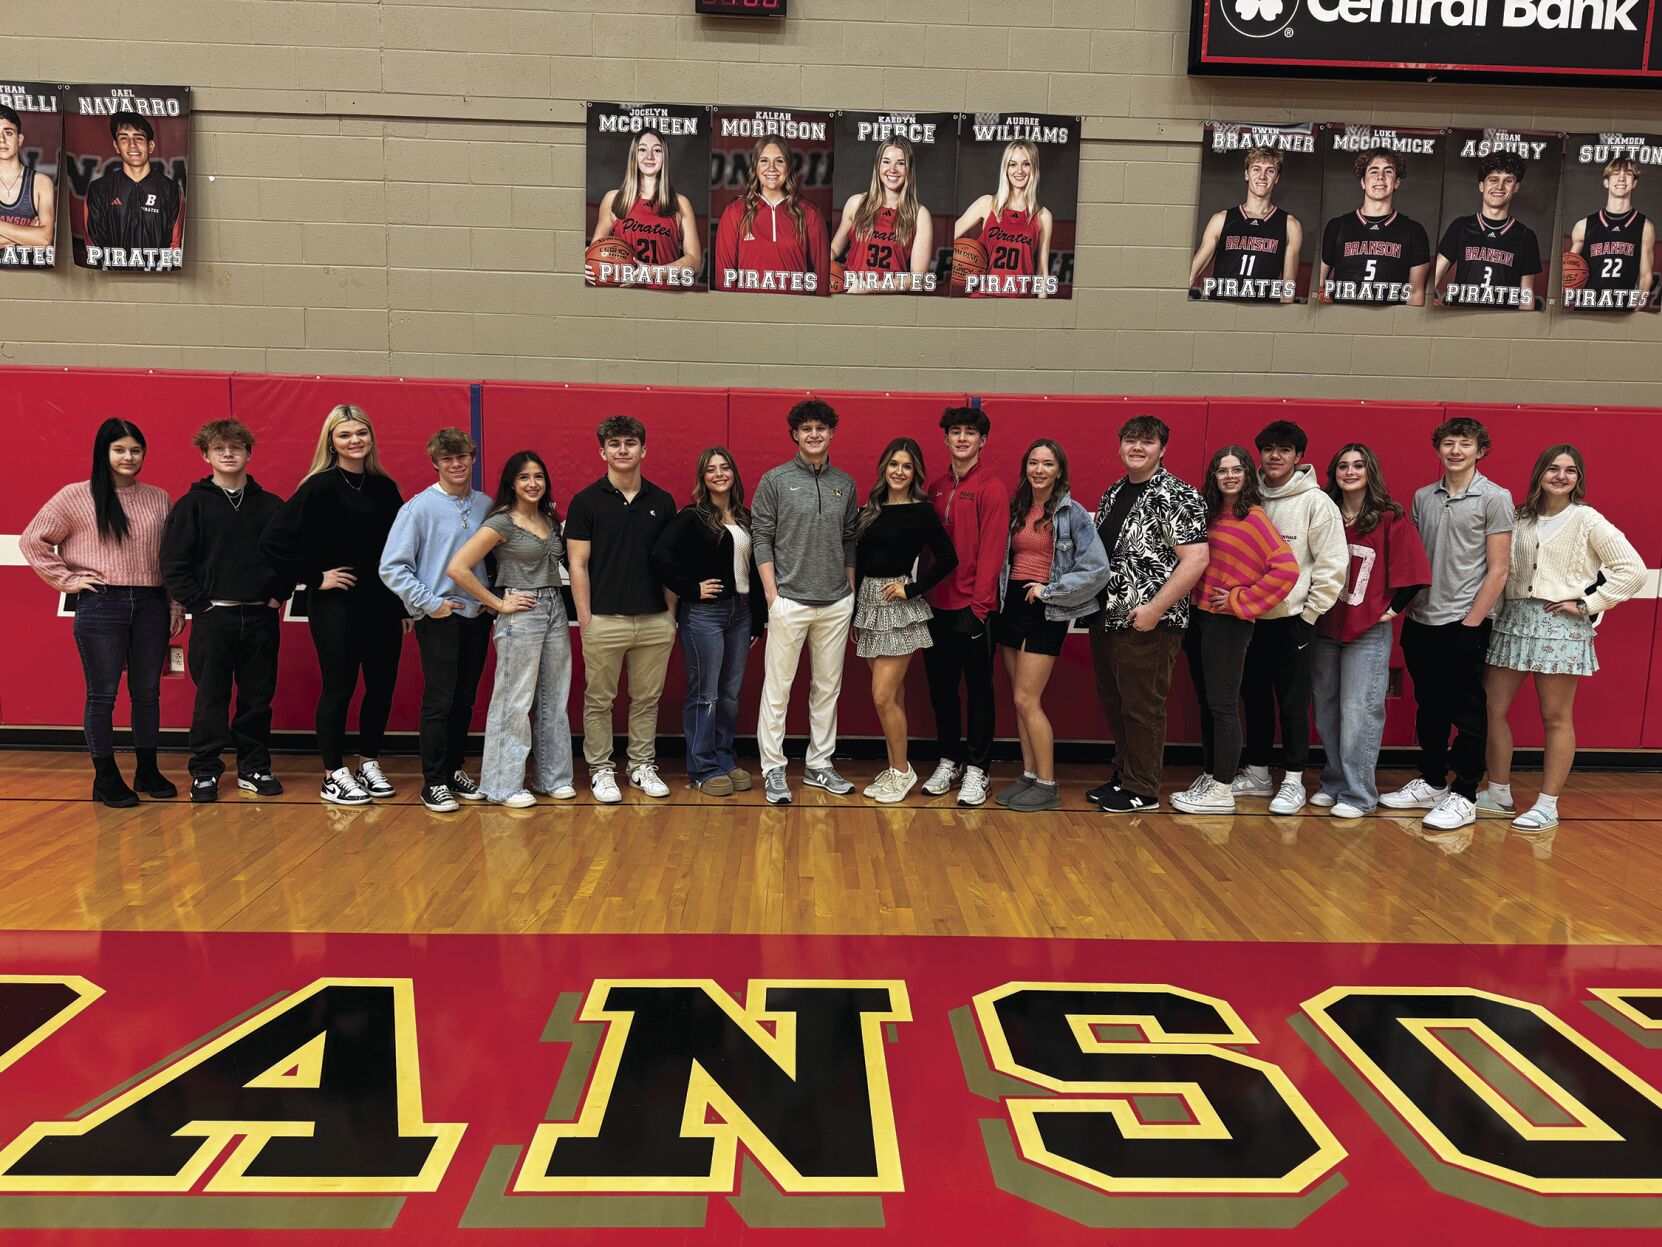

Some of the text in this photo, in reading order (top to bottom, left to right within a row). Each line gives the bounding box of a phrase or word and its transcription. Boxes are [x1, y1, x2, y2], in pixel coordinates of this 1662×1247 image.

[1502, 0, 1638, 31] Bank
[79, 96, 180, 116] NAVARRO
[629, 108, 669, 117] JOCELYN
[755, 111, 792, 121] KALEAH
[599, 114, 698, 135] MCQUEEN
[721, 118, 826, 141] MORRISON
[1005, 116, 1040, 126] AUBREE
[857, 121, 937, 144] PIERCE
[973, 124, 1069, 145] WILLIAMS
[1212, 131, 1315, 153] BRAWNER
[1374, 129, 1397, 138] LUKE
[1495, 132, 1521, 142] TEGAN
[1607, 137, 1645, 145] KAMDEN
[1332, 134, 1436, 155] MCCORMICK
[1579, 144, 1662, 165] SUTTON
[145, 194, 157, 206] B
[622, 218, 672, 237] Pirates
[988, 226, 1033, 246] Pirates
[0, 245, 55, 265] ATES
[637, 238, 658, 264] 21
[1225, 235, 1279, 254] BRANSON
[1344, 240, 1402, 259] BRANSON
[1590, 241, 1635, 257] BRANSON
[86, 247, 182, 268] PIRATES
[866, 243, 892, 269] 32
[993, 246, 1020, 270] 20
[1239, 254, 1256, 277] 11
[1465, 246, 1515, 267] BRANSON
[599, 263, 695, 287] PIRATES
[1364, 259, 1377, 281] 5
[1480, 265, 1493, 289] 3
[1601, 258, 1623, 278] 22
[723, 268, 818, 291] PIRATES
[843, 270, 937, 292] PIRATES
[965, 274, 1059, 295] PIRATES
[1203, 277, 1296, 299] PIRATES
[1323, 279, 1414, 302] PIRATES
[1445, 283, 1534, 305] PIRATES
[1563, 287, 1650, 308] PIRATES
[0, 976, 1662, 1193] ANSO
